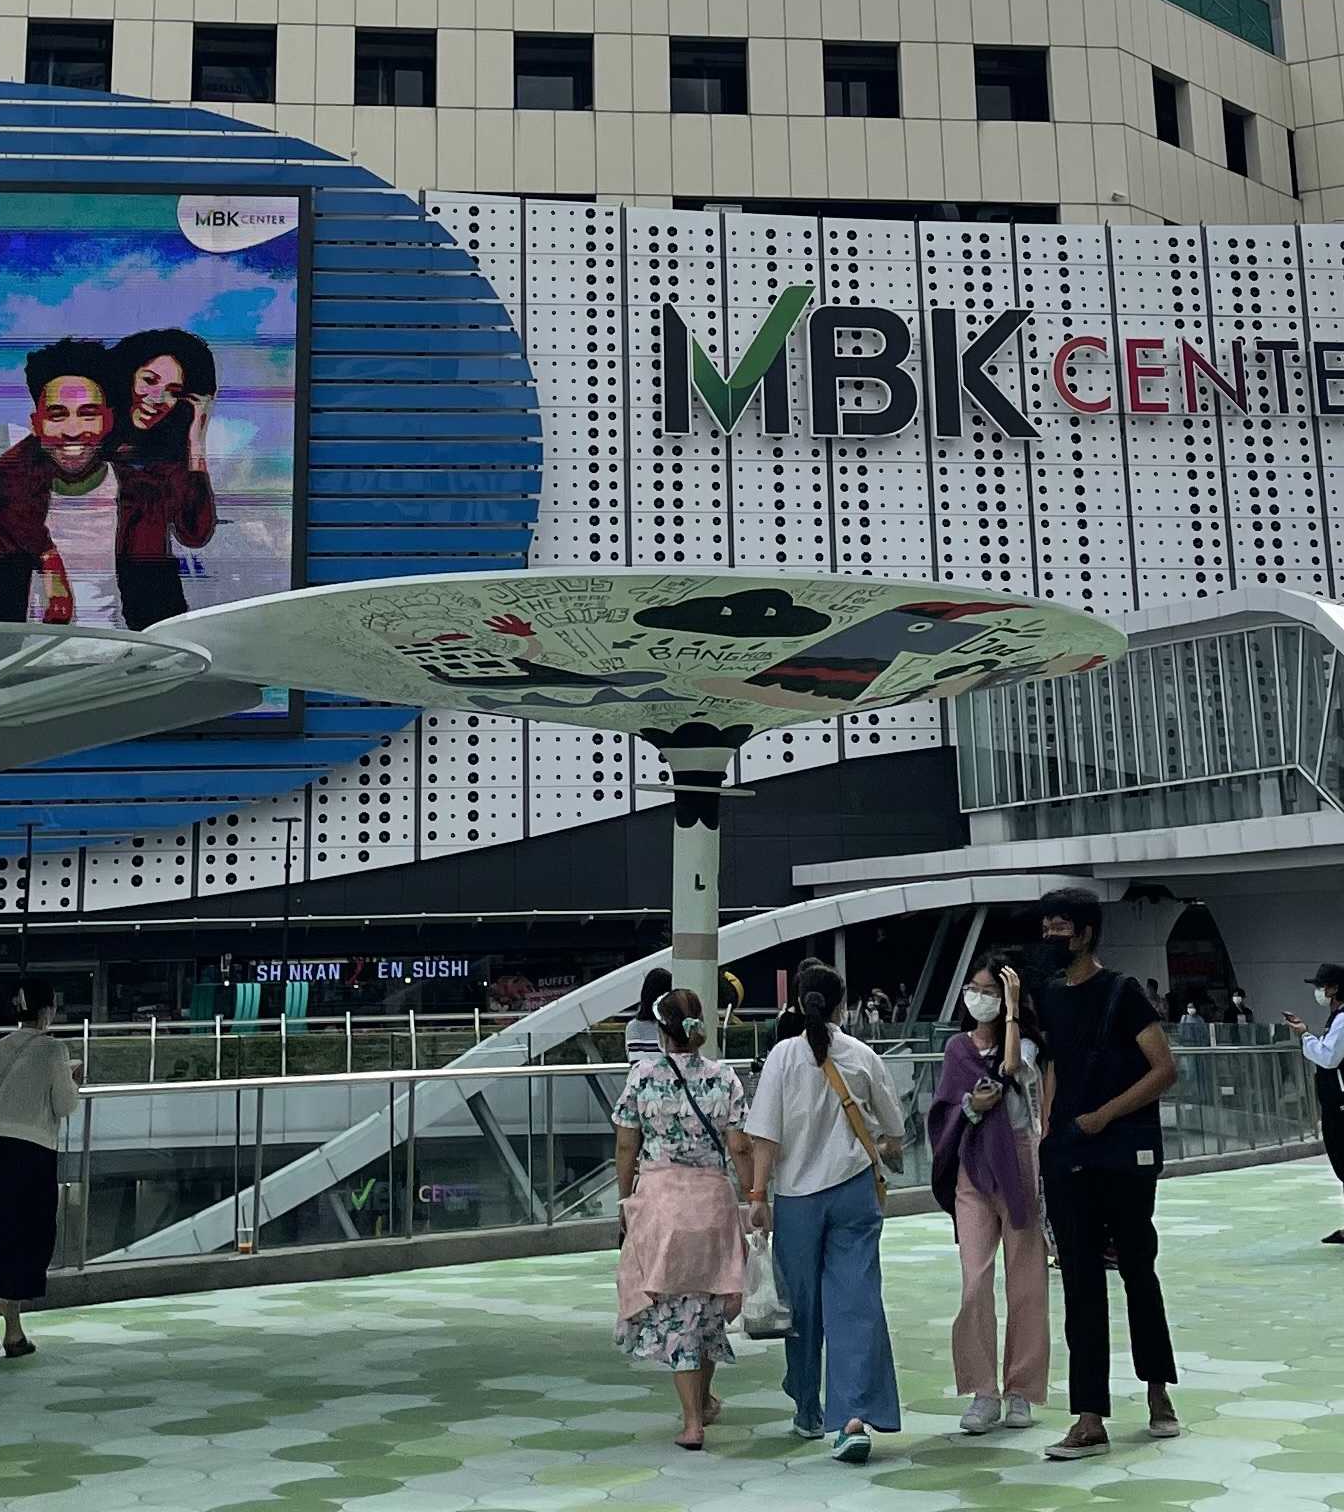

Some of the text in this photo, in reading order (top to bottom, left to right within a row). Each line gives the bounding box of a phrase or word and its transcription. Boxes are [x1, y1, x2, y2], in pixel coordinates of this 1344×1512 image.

[195, 209, 286, 228] MBK CENTER
[661, 284, 1043, 441] MBK
[482, 577, 614, 605] JESUS
[412, 960, 469, 978] SUSHI
[538, 976, 577, 986] BUFFET
